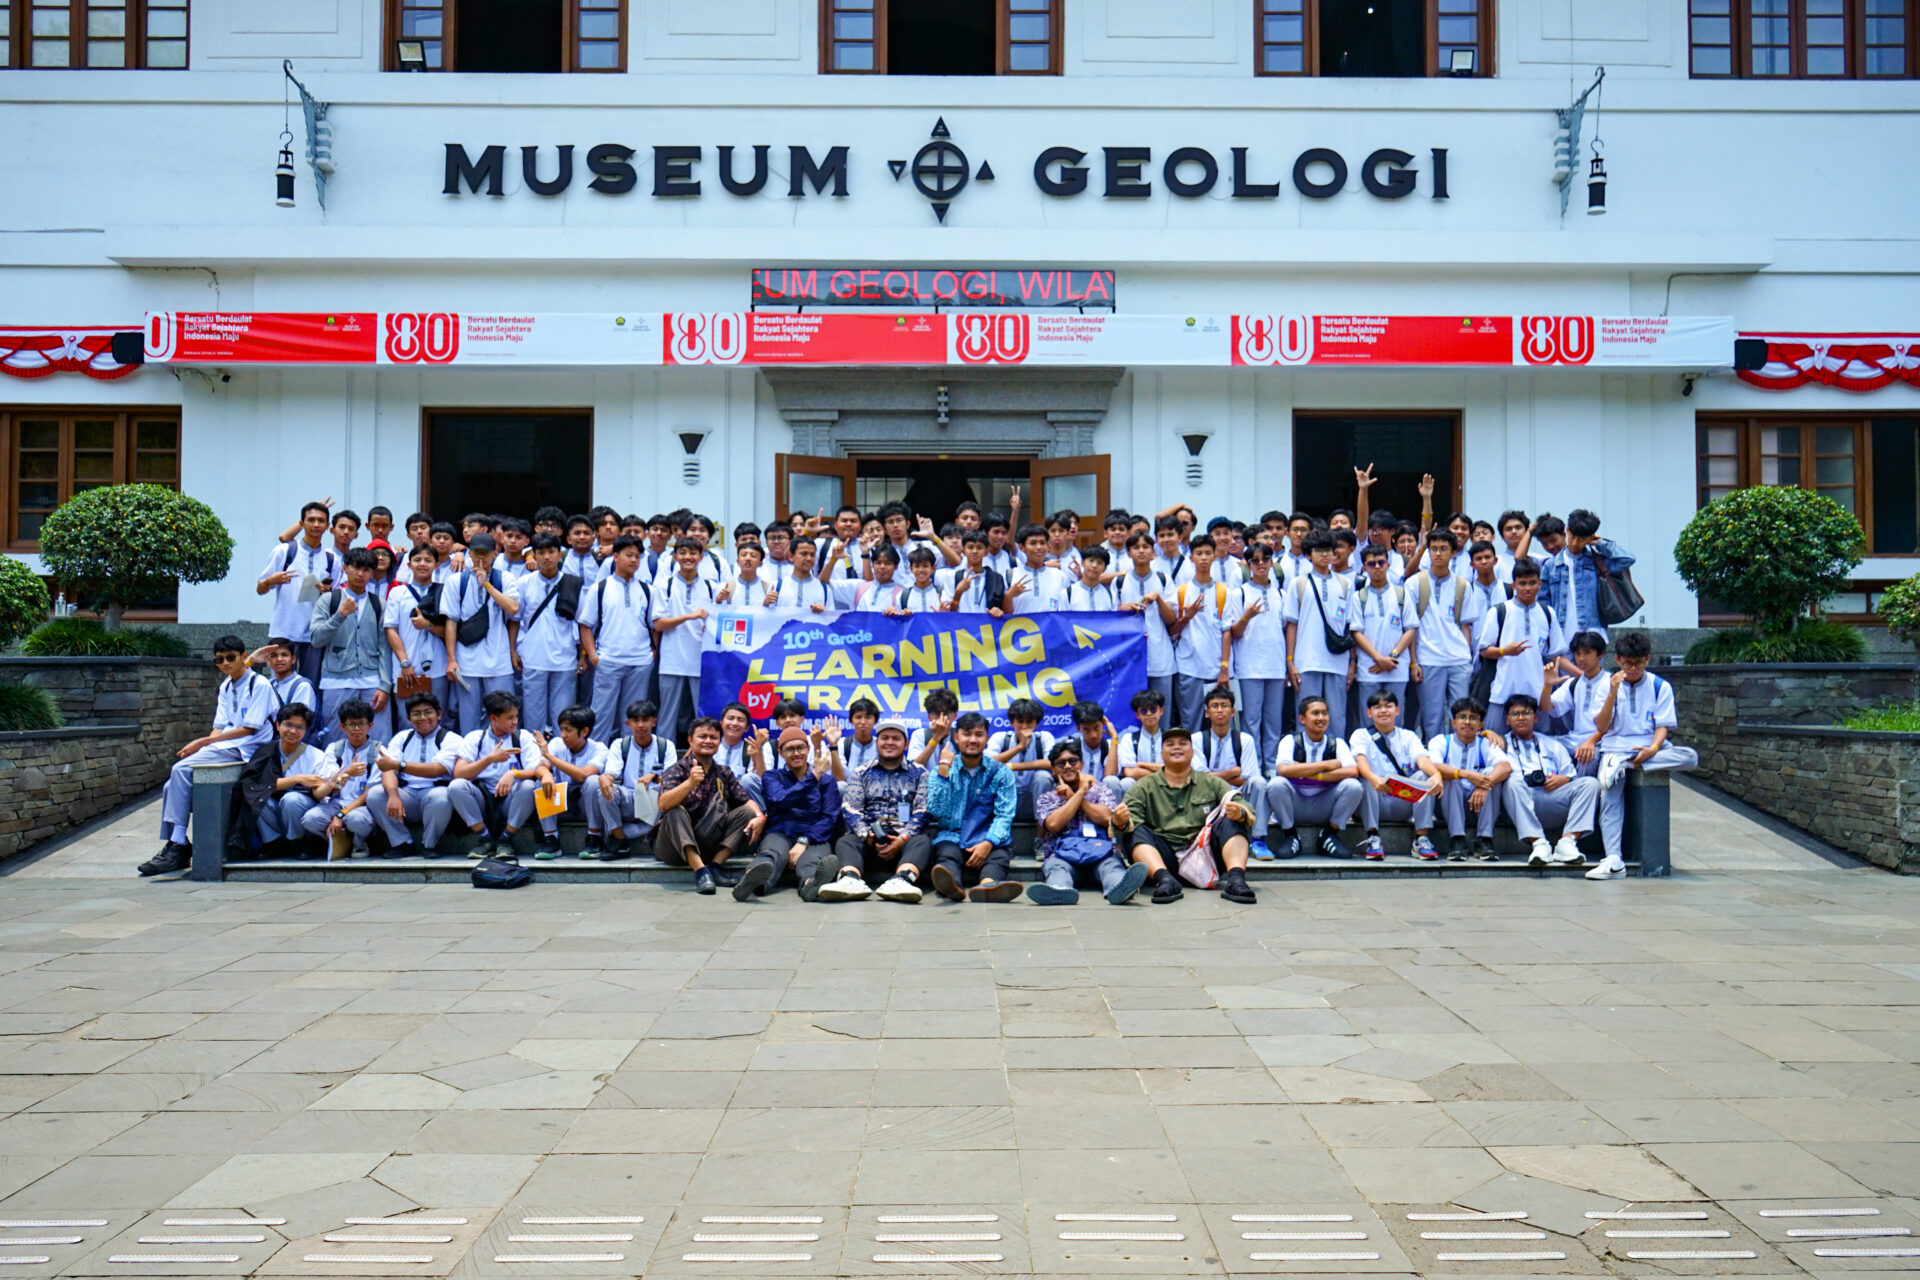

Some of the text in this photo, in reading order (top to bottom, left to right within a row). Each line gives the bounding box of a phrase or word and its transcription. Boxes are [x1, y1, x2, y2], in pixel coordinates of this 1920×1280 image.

[442, 143, 1451, 199] MUSEUM GEOLOGI
[830, 270, 1006, 305] GEOLOGI,
[215, 315, 252, 323] Berdaulat
[754, 316, 822, 324] Bersatu Berdaulat
[1069, 316, 1106, 324] Berdaulat
[1321, 316, 1389, 325] Bersatu Berdaulat
[184, 323, 248, 332] Rakyat Sejahtera
[468, 325, 532, 334] Rakyat Sejahtera
[754, 325, 819, 334] Rakyat Sejahtera
[1038, 325, 1102, 334] Rakyat Sejahtera
[1321, 326, 1385, 335] Rakyat Sejahtera
[1602, 327, 1665, 335] Rakyat Sejahtera
[184, 332, 240, 342] Indonesia Maju
[385, 313, 459, 364] 80
[505, 334, 523, 343] Maju
[670, 312, 747, 364] 80
[754, 334, 810, 343] Indonesia Maju
[956, 314, 1029, 364] 80
[1076, 334, 1093, 343] Maju
[1238, 315, 1314, 365] 80
[1359, 335, 1377, 344] Maju
[1521, 316, 1594, 365] 80
[1640, 336, 1657, 344] Maju
[783, 629, 872, 649] 10th Grade
[747, 617, 1046, 682] LEARNING
[774, 667, 1077, 712] TRAVELING
[748, 692, 771, 709] by
[1043, 714, 1072, 726] 2025
